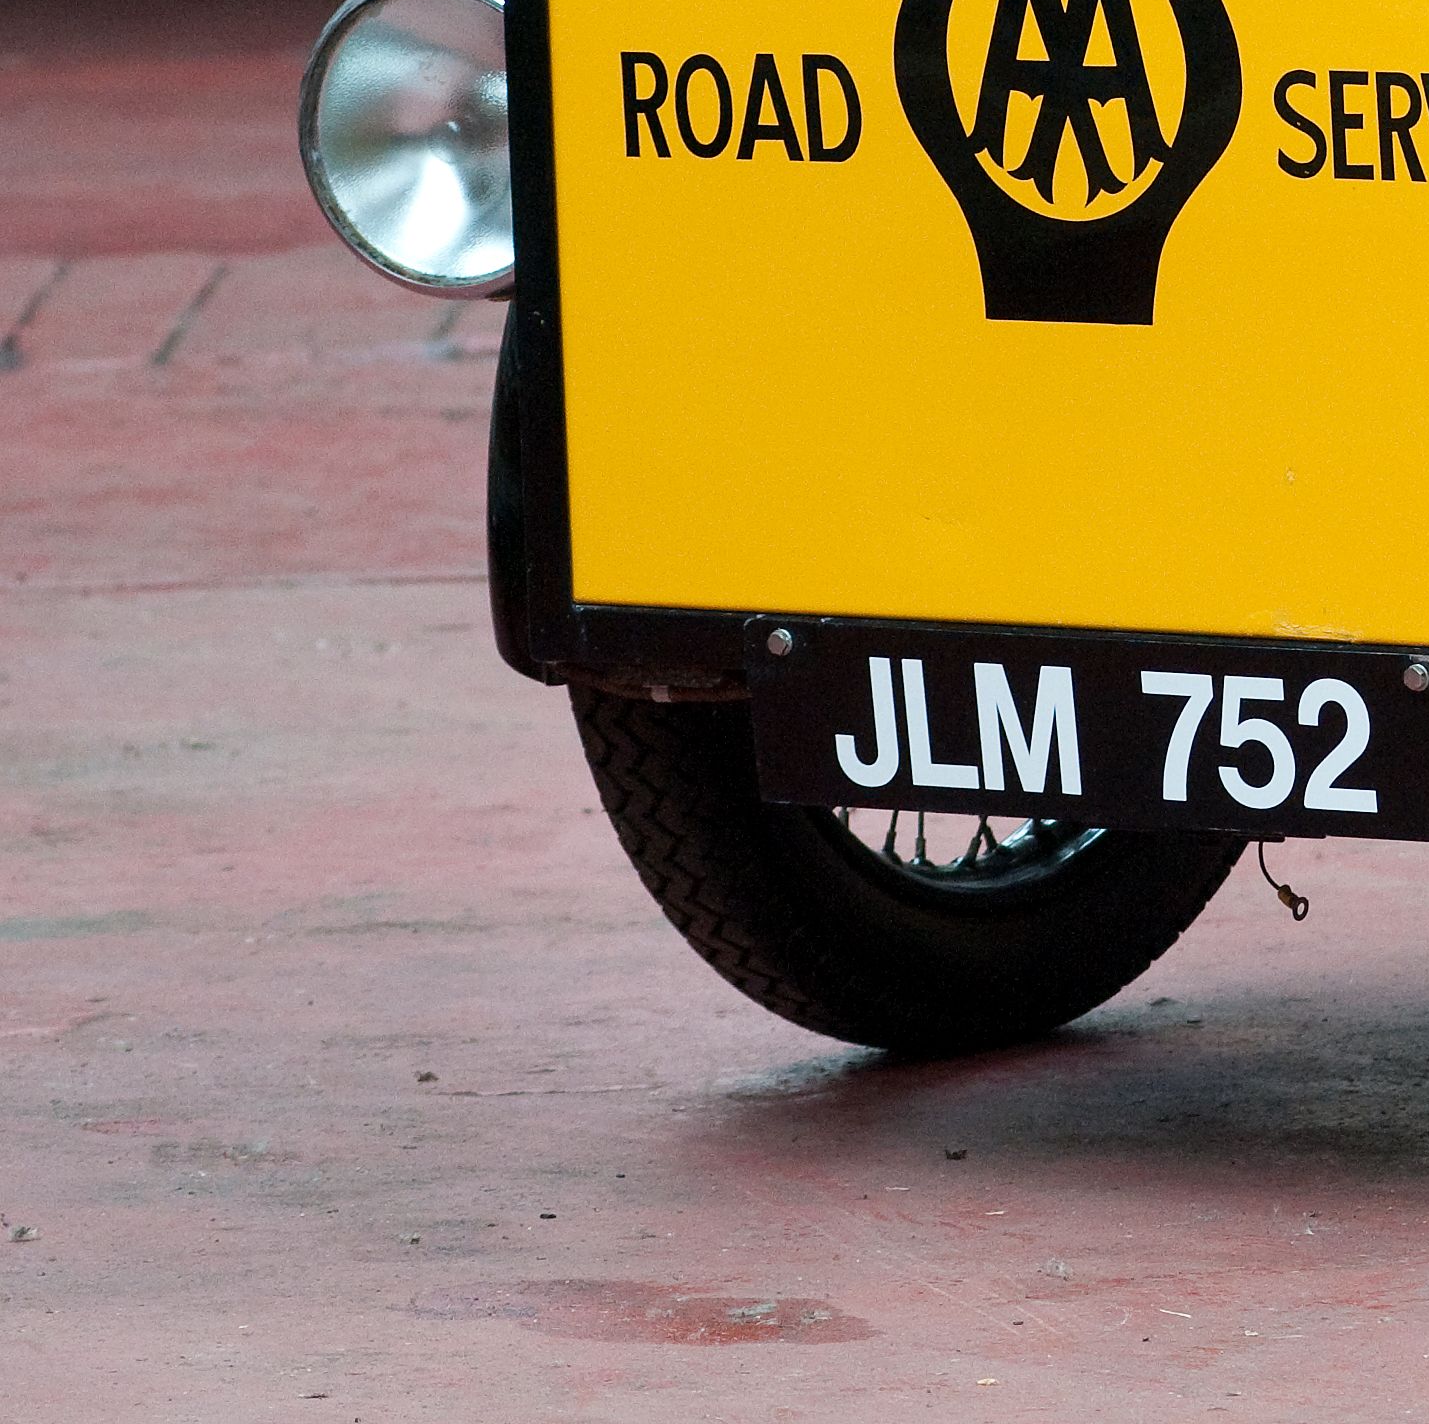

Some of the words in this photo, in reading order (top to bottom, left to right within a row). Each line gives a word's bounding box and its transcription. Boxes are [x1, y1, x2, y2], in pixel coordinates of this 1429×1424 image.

[620, 51, 862, 163] ROAD
[835, 656, 1083, 796] JLM
[1141, 670, 1379, 814] 752
